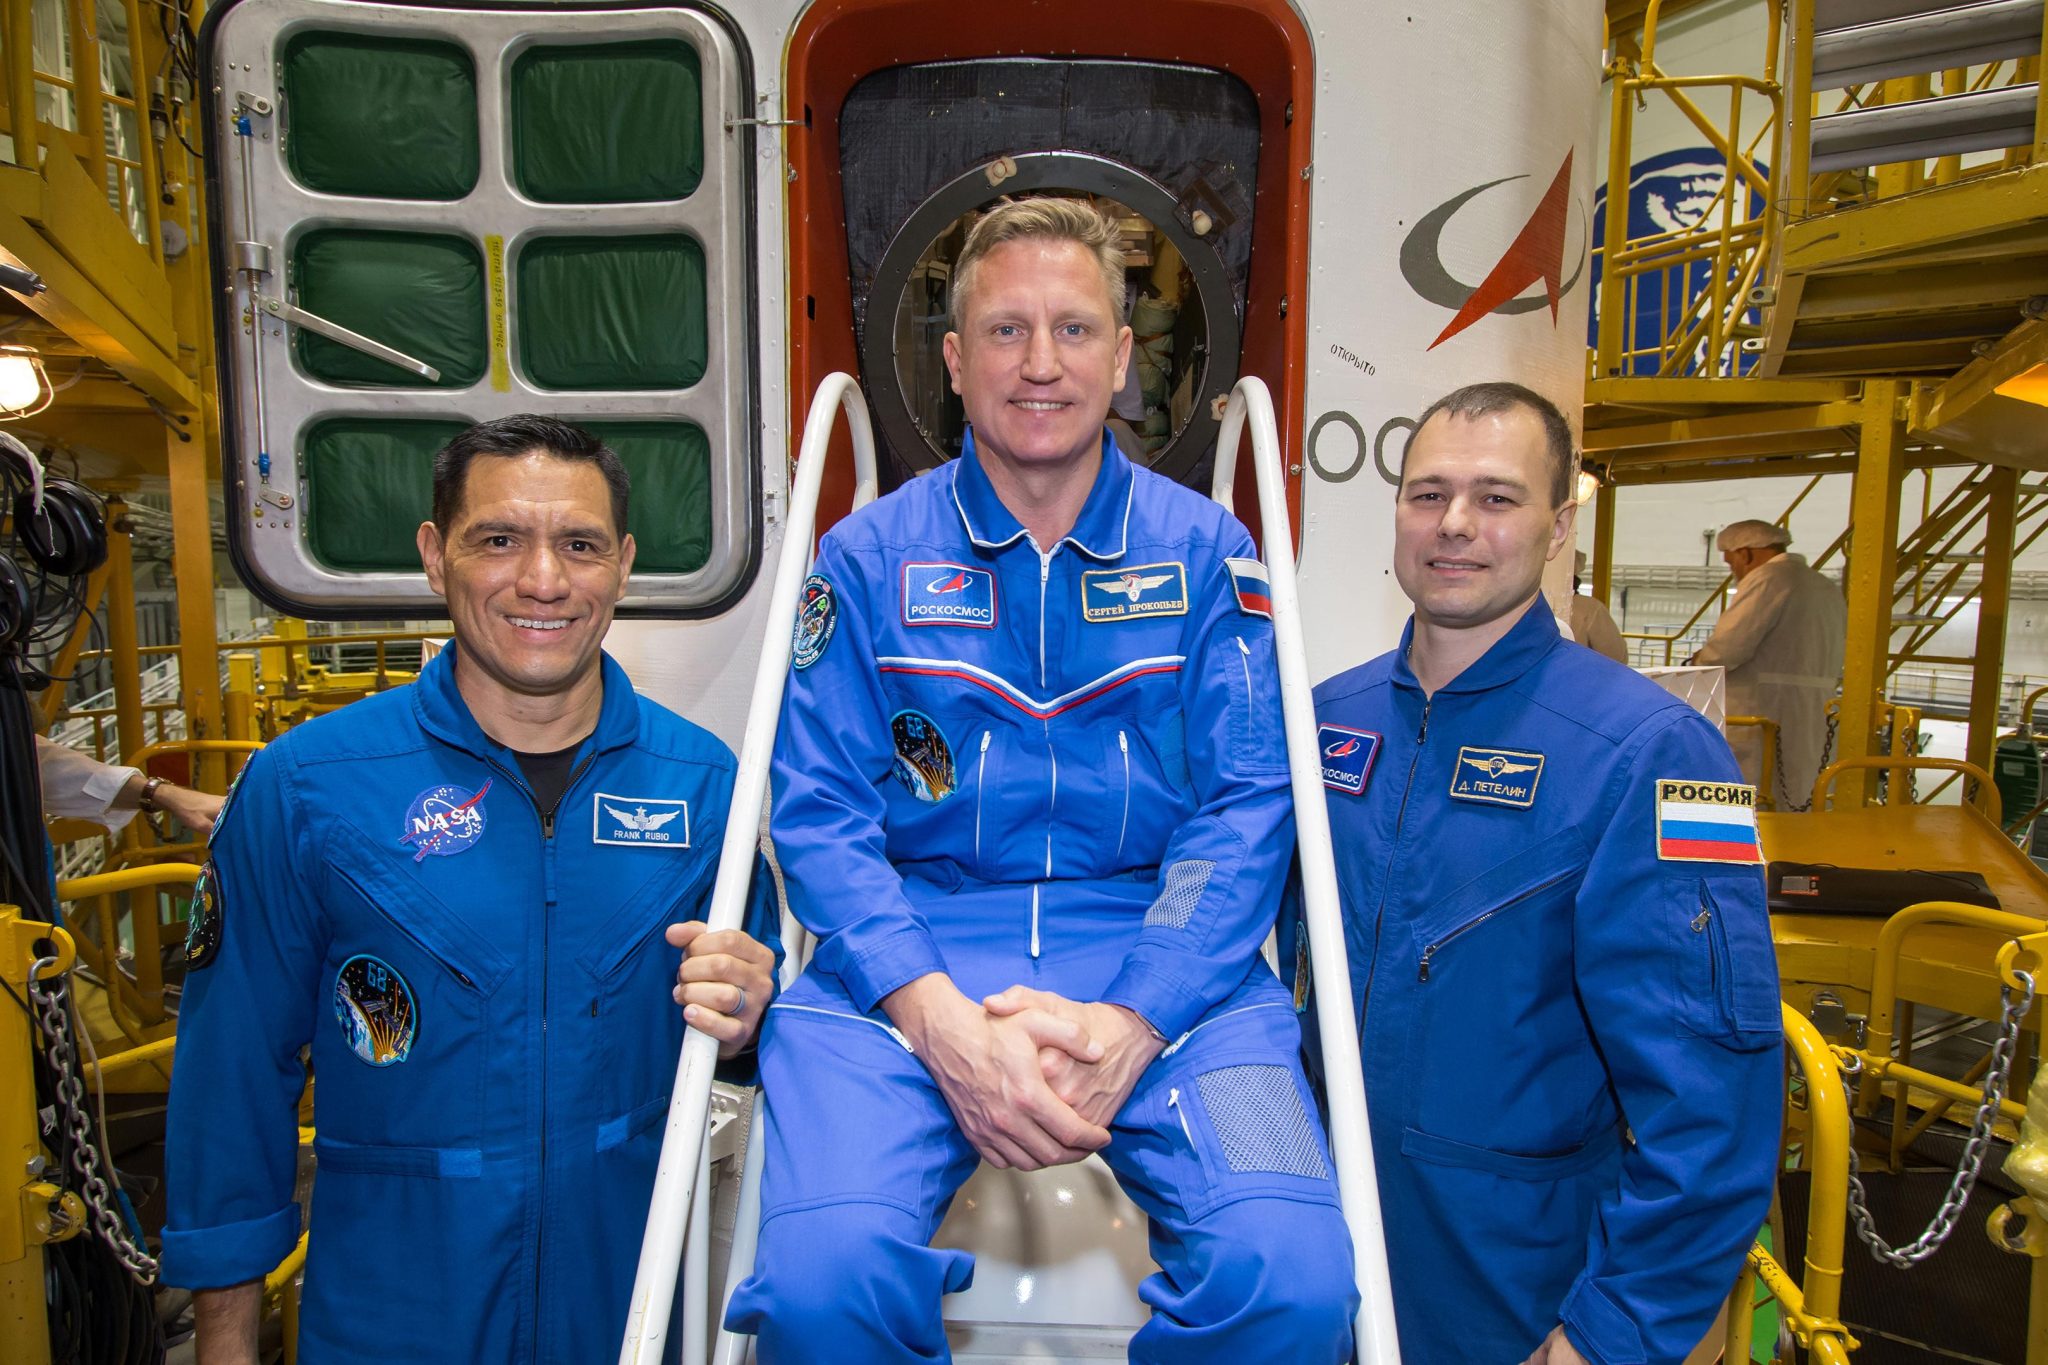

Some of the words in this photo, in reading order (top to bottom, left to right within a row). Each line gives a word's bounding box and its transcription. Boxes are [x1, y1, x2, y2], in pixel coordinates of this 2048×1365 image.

[1330, 343, 1376, 377] ОТКРЫТО
[911, 605, 989, 618] РОСКОСМОС
[1088, 604, 1125, 616] СЕРГЕЙ
[1129, 600, 1183, 613] ПРОКОПЬЕВ
[905, 715, 925, 740] 68
[1458, 780, 1471, 792] Д.
[1473, 781, 1526, 798] ПЕТЕЛИН
[1662, 783, 1752, 806] РОССИЯ
[412, 806, 482, 834] NASA
[613, 830, 640, 840] FRANK
[645, 832, 669, 841] RUBIO
[367, 961, 387, 992] 68
